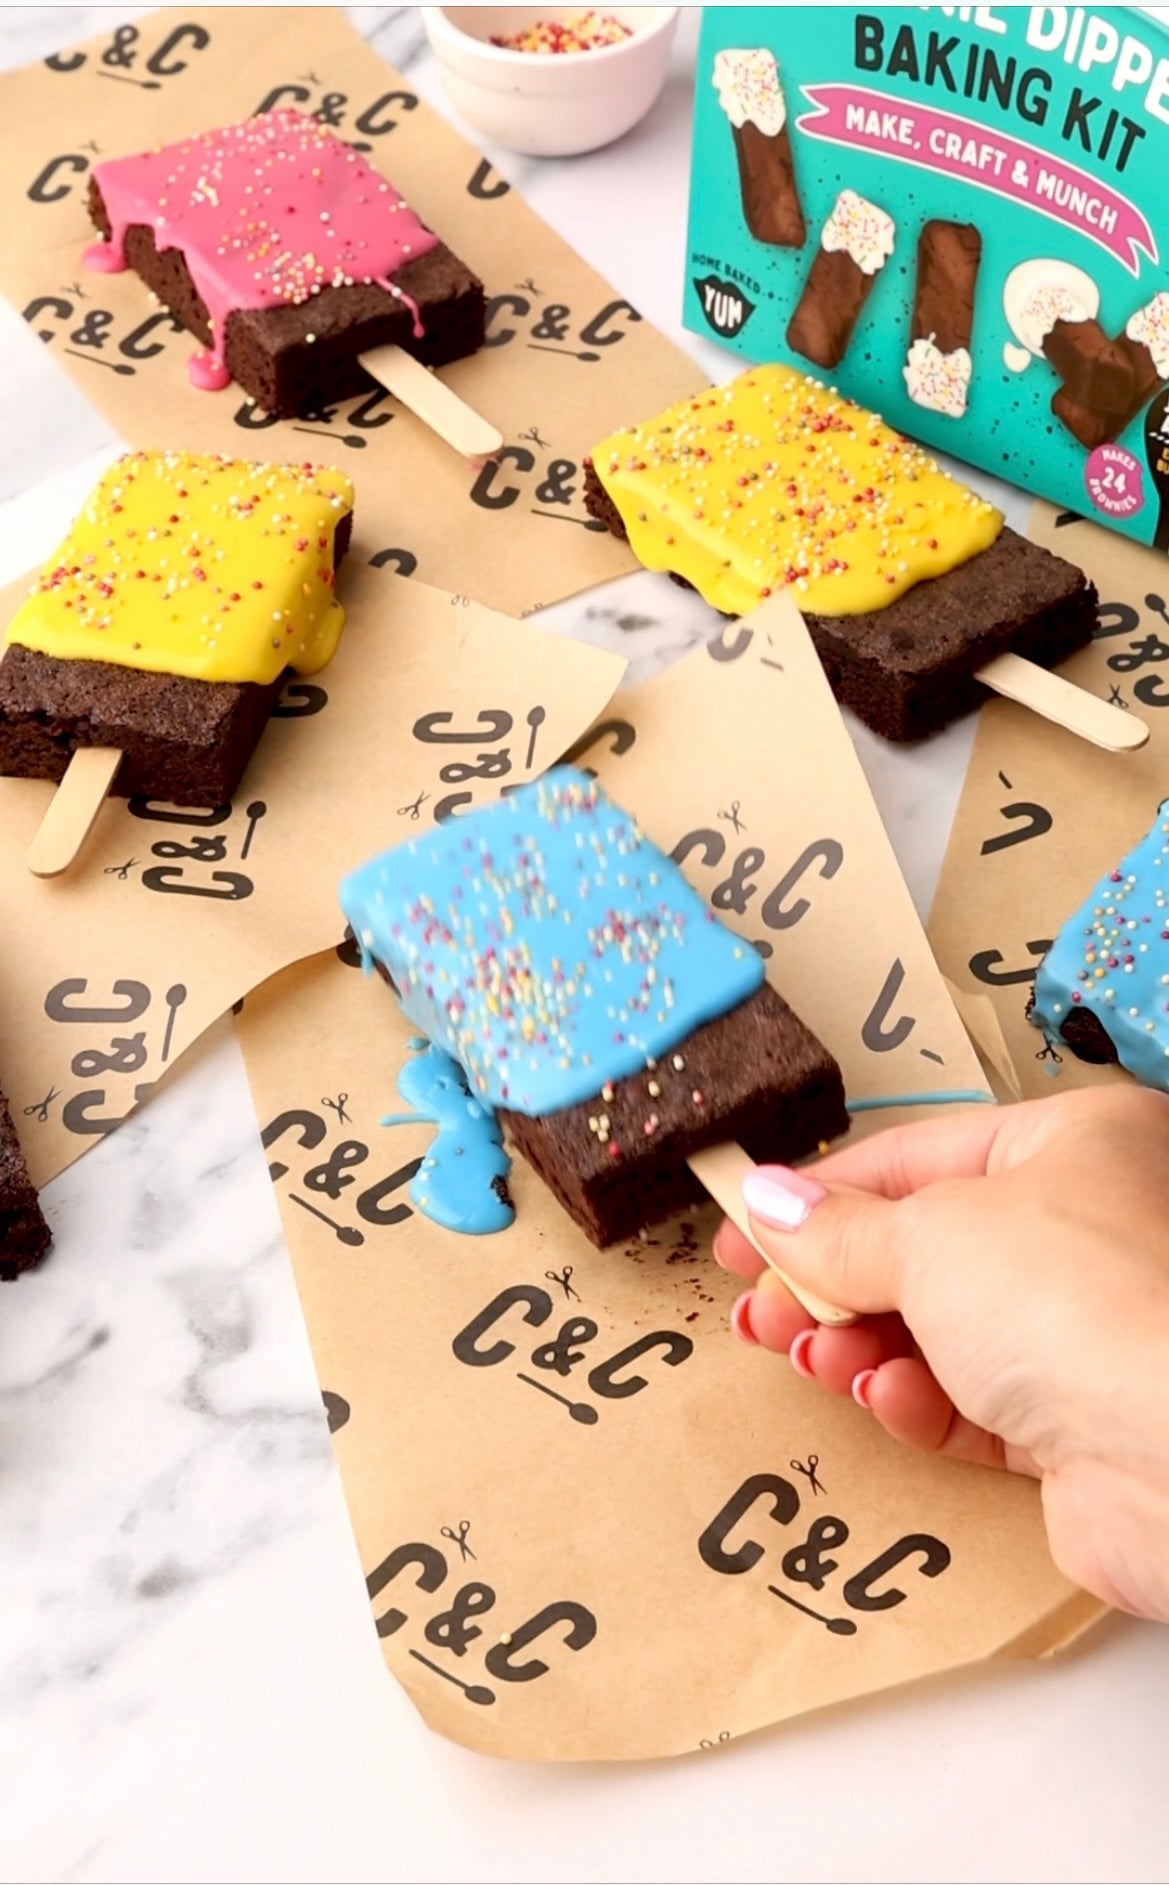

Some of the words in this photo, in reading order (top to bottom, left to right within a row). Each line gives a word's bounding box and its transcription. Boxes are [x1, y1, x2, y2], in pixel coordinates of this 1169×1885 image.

[855, 14, 1052, 126] BAKING
[1062, 87, 1146, 172] KIT
[846, 104, 921, 149] MAKE,
[929, 129, 1007, 176] CRAFT
[1011, 160, 1029, 188] &
[1036, 170, 1118, 234] MUNCH
[692, 254, 721, 271] HOME
[725, 263, 761, 295] BAKED
[484, 295, 643, 346] C&C
[705, 284, 742, 329] YUM
[470, 446, 577, 510] C&
[1102, 449, 1136, 471] MAKES
[1102, 466, 1126, 494] 24
[1089, 478, 1137, 512] BROWNIES
[452, 1284, 693, 1399] C&C
[698, 1473, 951, 1612] C&C
